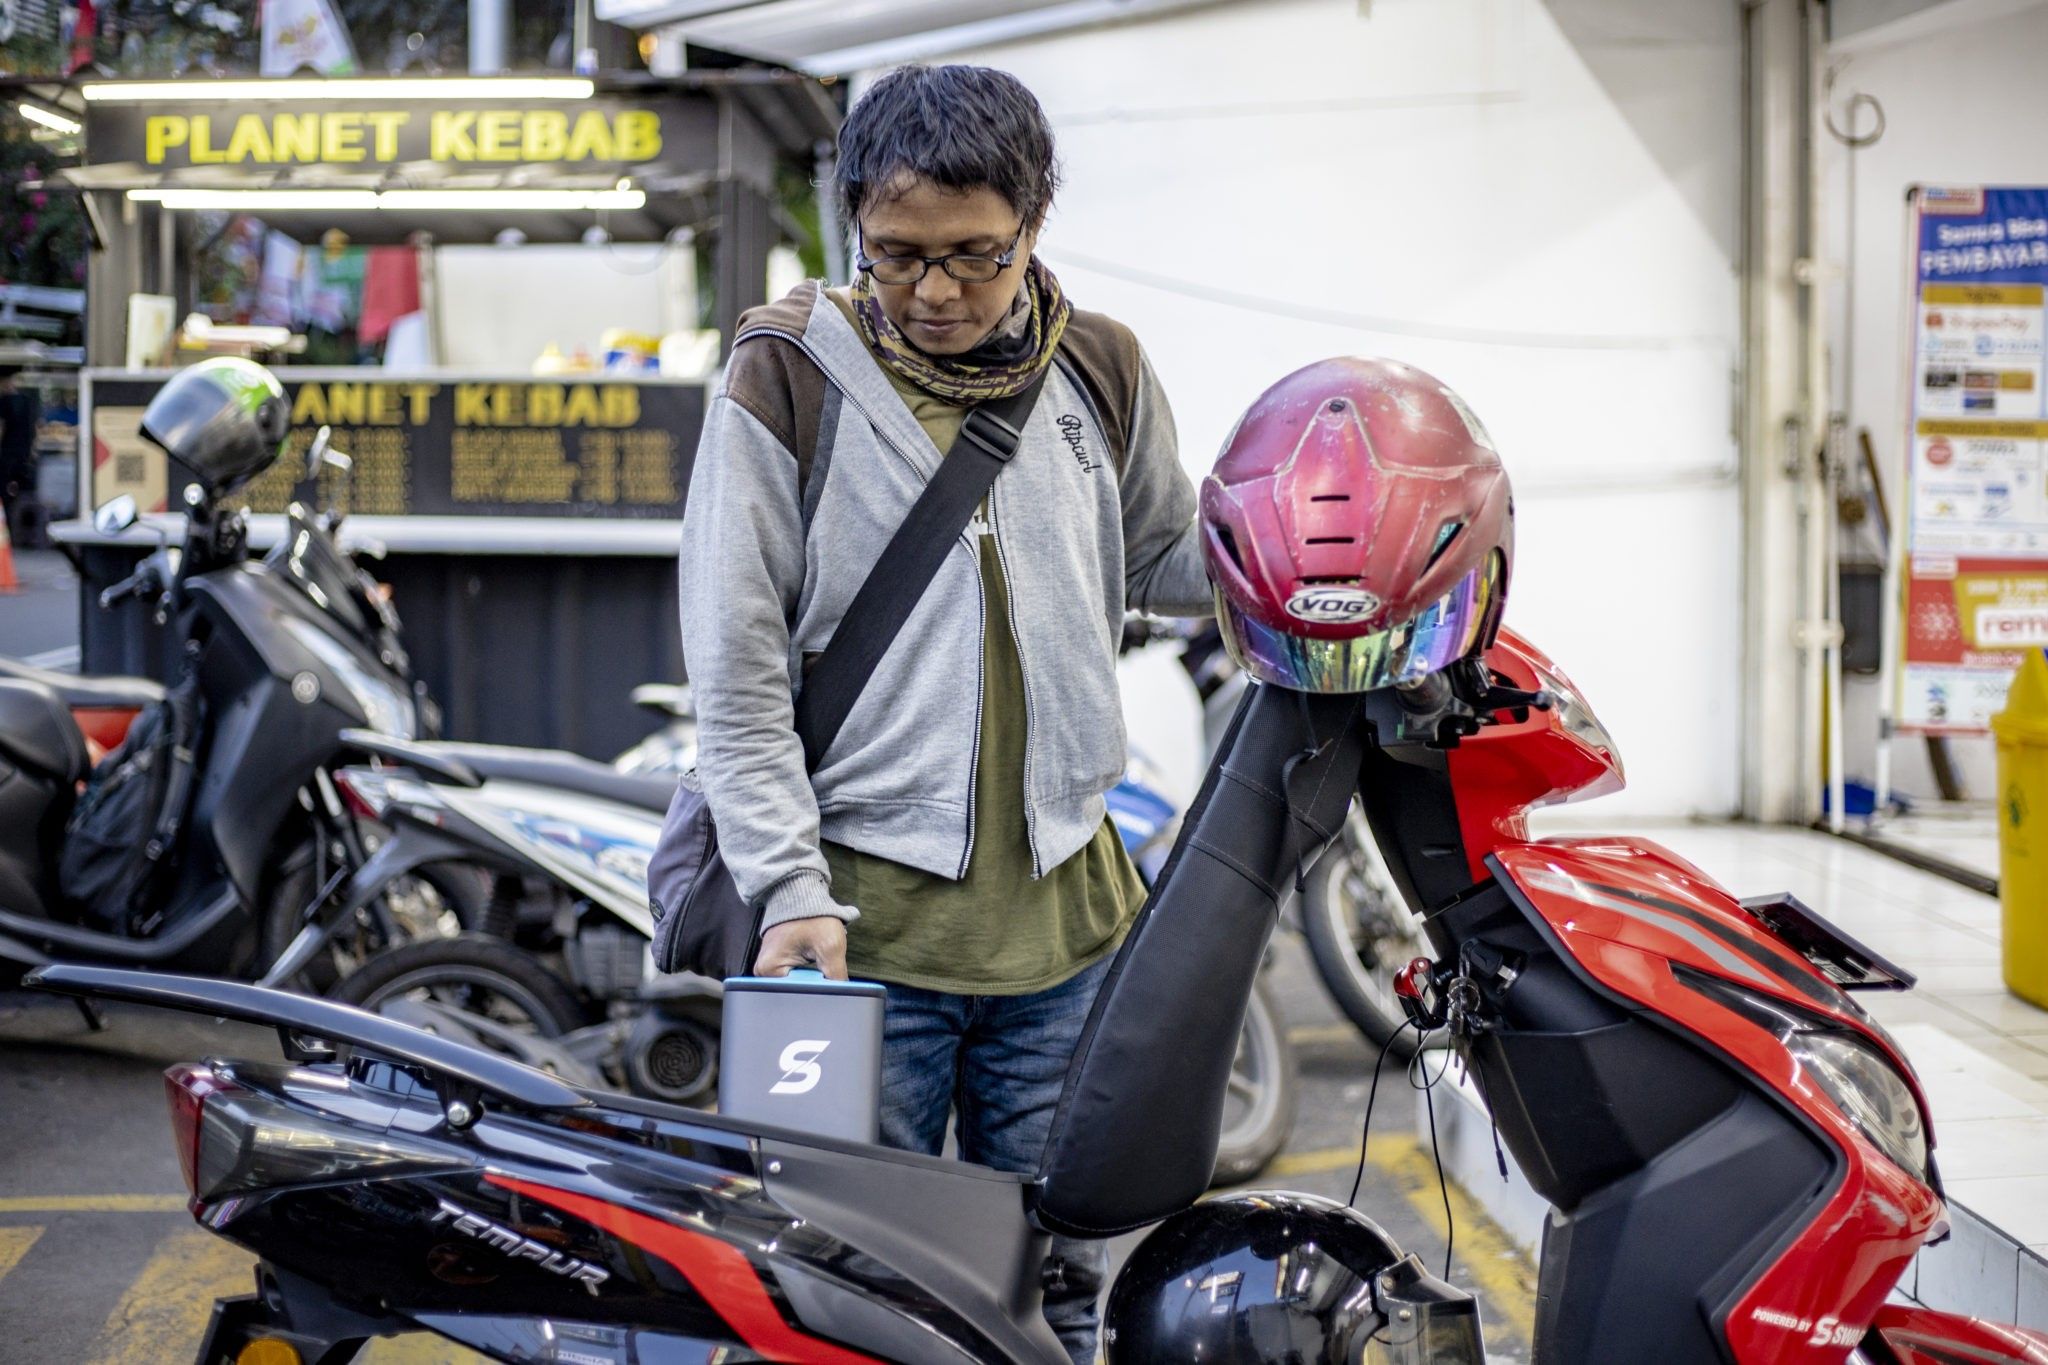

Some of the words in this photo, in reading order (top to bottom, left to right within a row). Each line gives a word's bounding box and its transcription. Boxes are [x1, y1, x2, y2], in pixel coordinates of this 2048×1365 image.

[145, 110, 411, 165] PLANET
[430, 109, 662, 162] KEBAB
[289, 382, 441, 426] ANET
[453, 382, 642, 428] KEBAB
[1056, 414, 1102, 473] Ripcurl
[1301, 598, 1366, 613] VOG
[430, 1198, 611, 1297] TEMPUR
[1751, 1307, 1798, 1330] POWERED
[1797, 1319, 1813, 1333] BY
